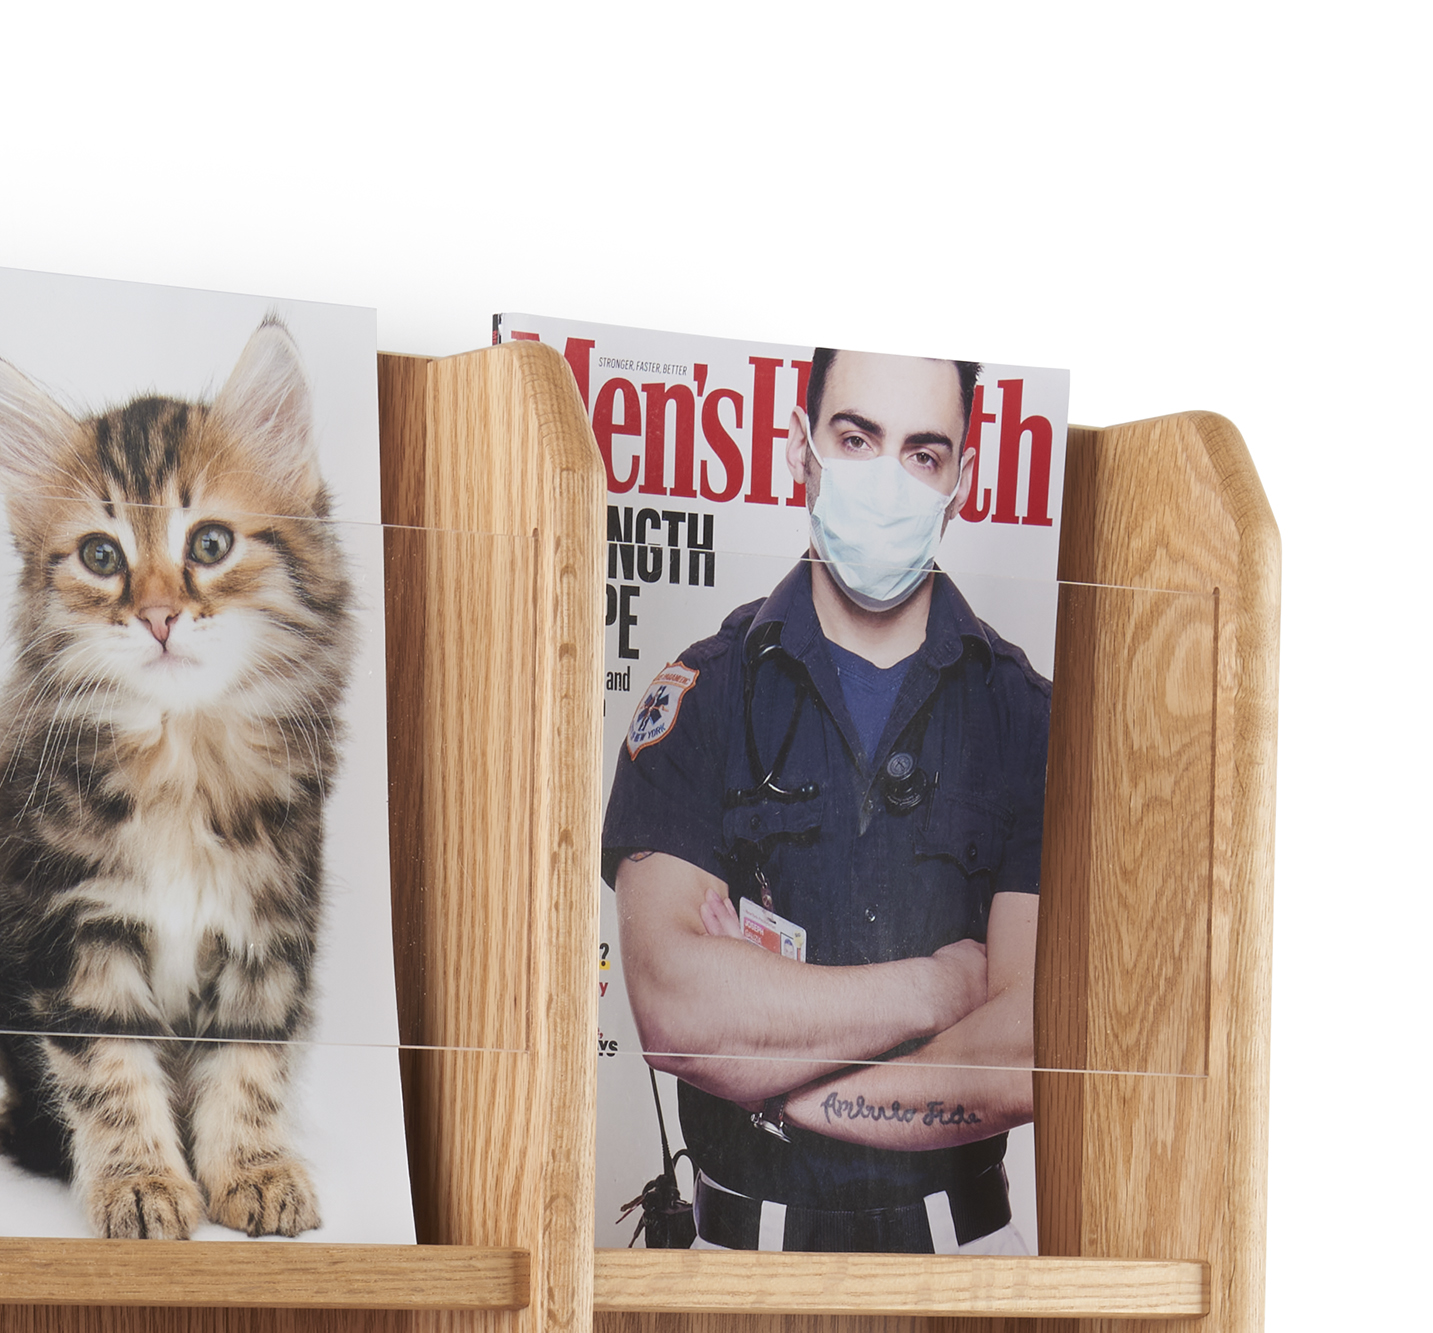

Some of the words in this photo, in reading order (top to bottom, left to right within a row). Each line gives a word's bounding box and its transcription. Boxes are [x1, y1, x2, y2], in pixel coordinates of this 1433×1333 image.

[598, 357, 635, 372] STRONGER,
[636, 360, 662, 374] FASTER,
[663, 363, 687, 376] BETTER
